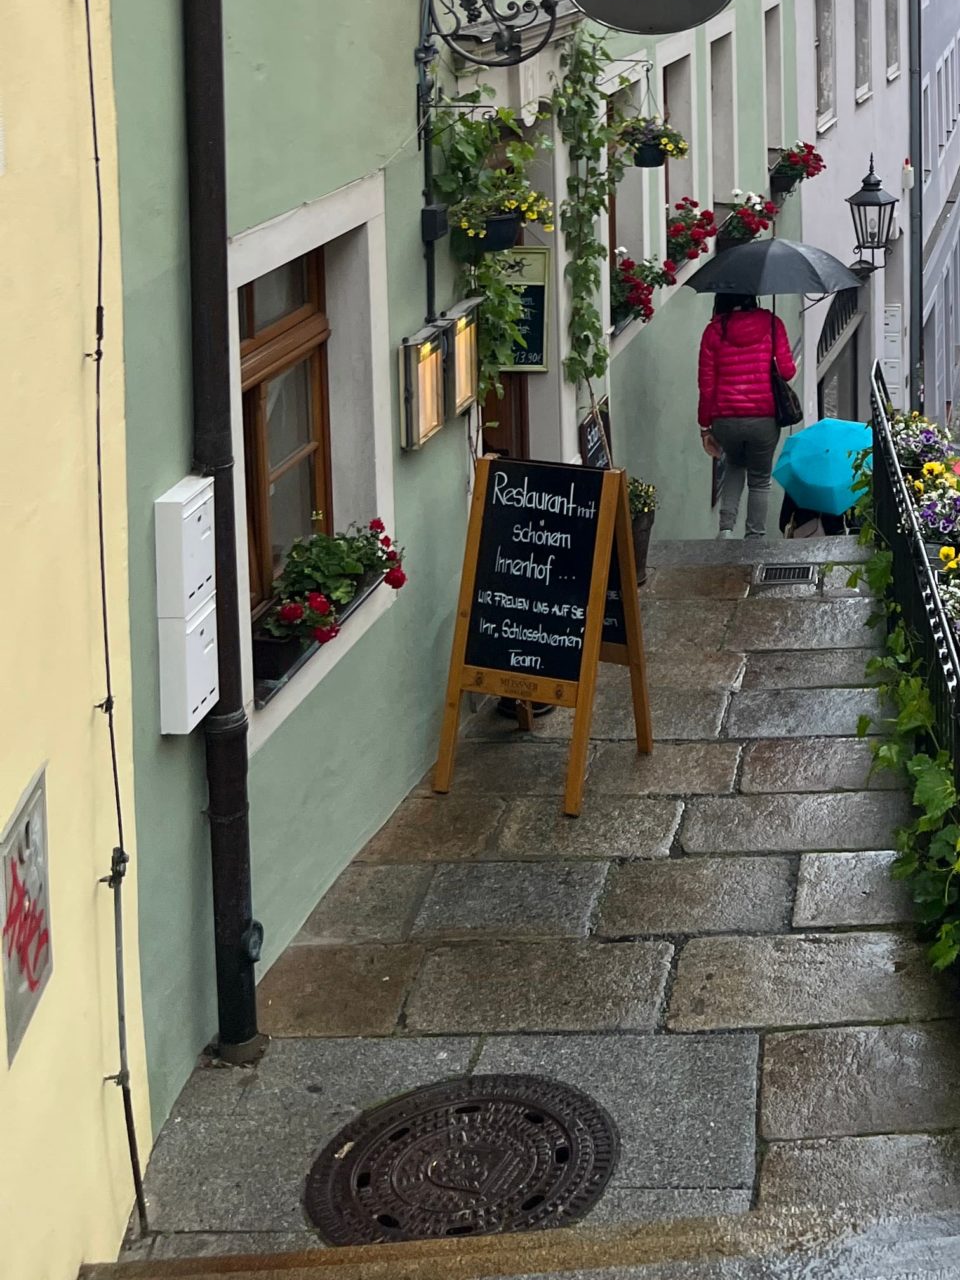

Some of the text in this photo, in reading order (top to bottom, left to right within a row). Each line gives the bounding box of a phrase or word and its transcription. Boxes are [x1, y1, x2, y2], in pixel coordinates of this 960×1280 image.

[492, 472, 596, 520] Restaurant mit
[478, 590, 492, 604] WIR
[494, 592, 529, 611] FREUEN
[532, 600, 550, 614] UNS
[551, 604, 570, 617] AUF
